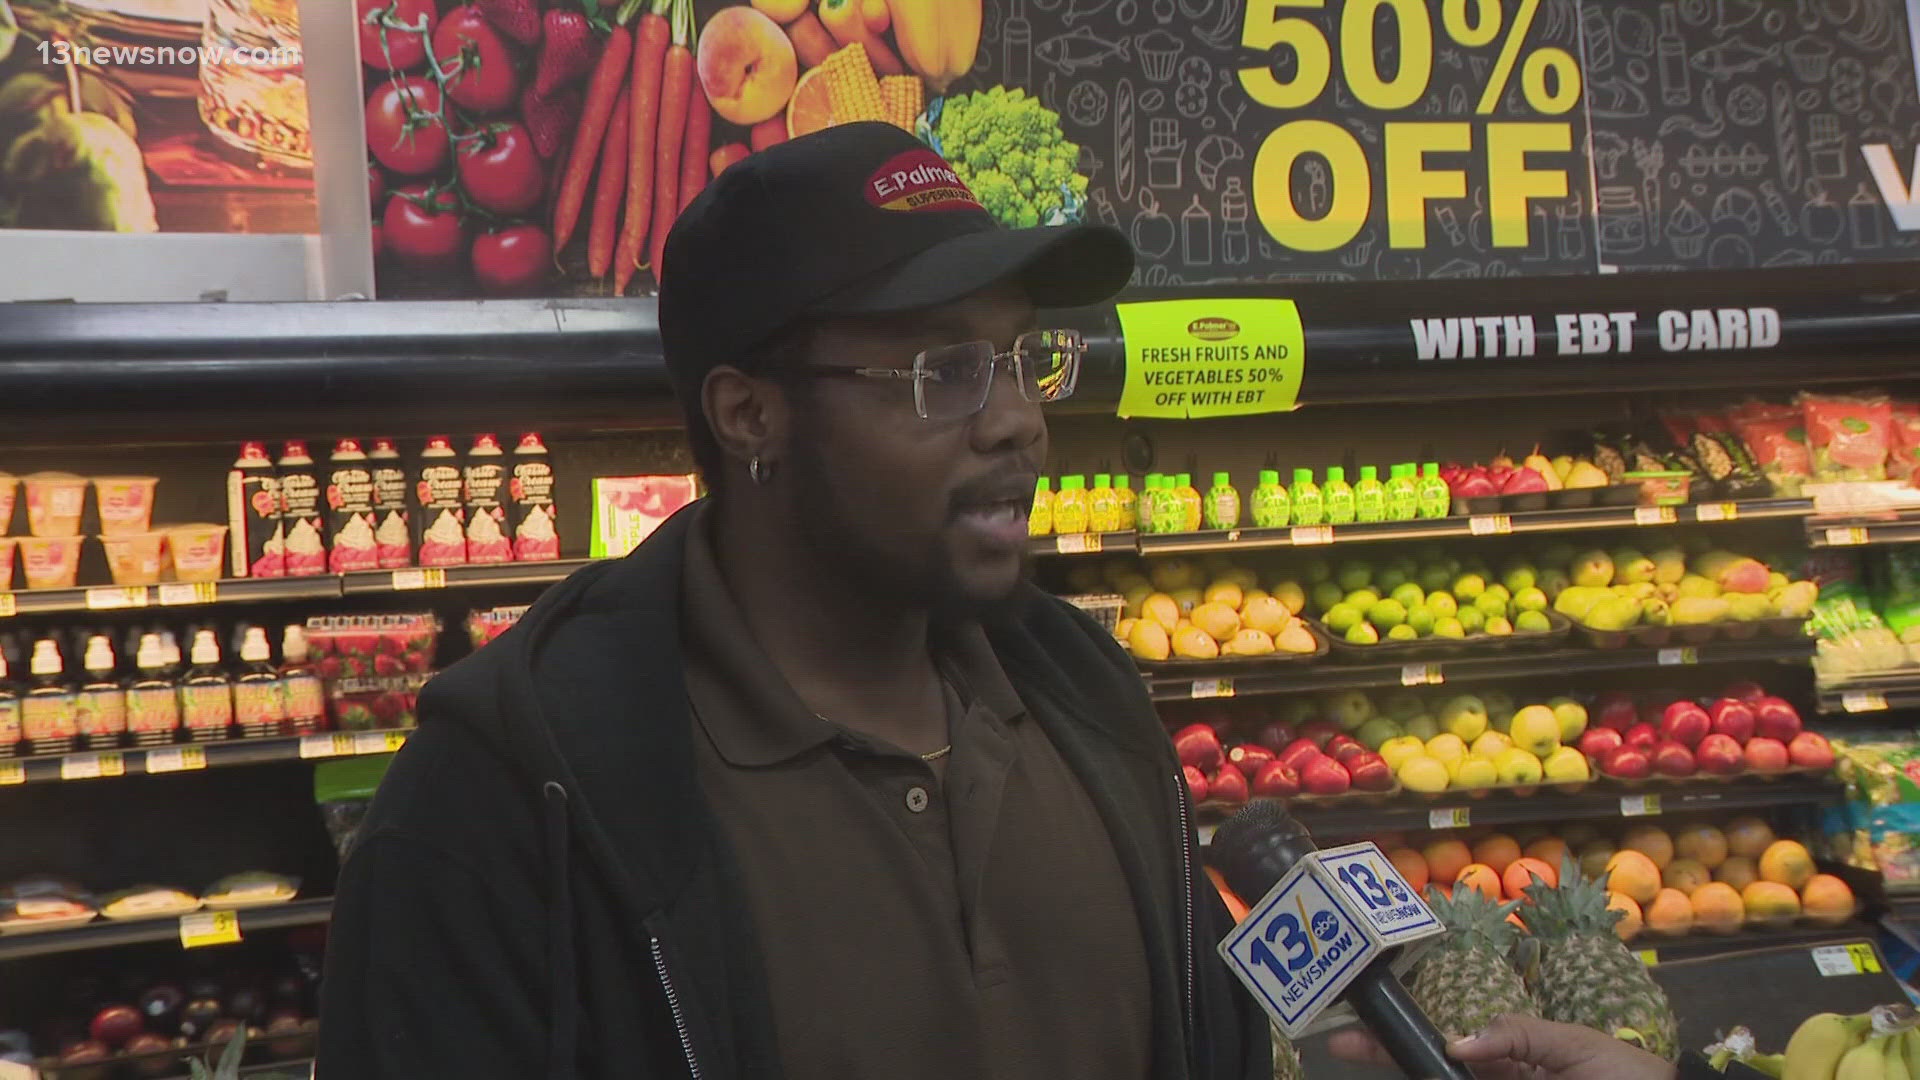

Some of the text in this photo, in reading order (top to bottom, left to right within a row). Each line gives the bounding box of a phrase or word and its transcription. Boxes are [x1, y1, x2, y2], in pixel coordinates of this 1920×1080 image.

[1237, 0, 1582, 114] 50%
[1252, 120, 1574, 252] OFF
[1142, 344, 1288, 363] FRESH FRUITS AND
[1410, 307, 1781, 360] WITH EBT CARD
[1144, 368, 1283, 385] VEGETABLES 50%
[1155, 390, 1265, 406] OFF WITH EBT
[1338, 863, 1391, 910] 13
[1251, 913, 1313, 987] 13
[1281, 932, 1353, 1008] NEWSNOW
